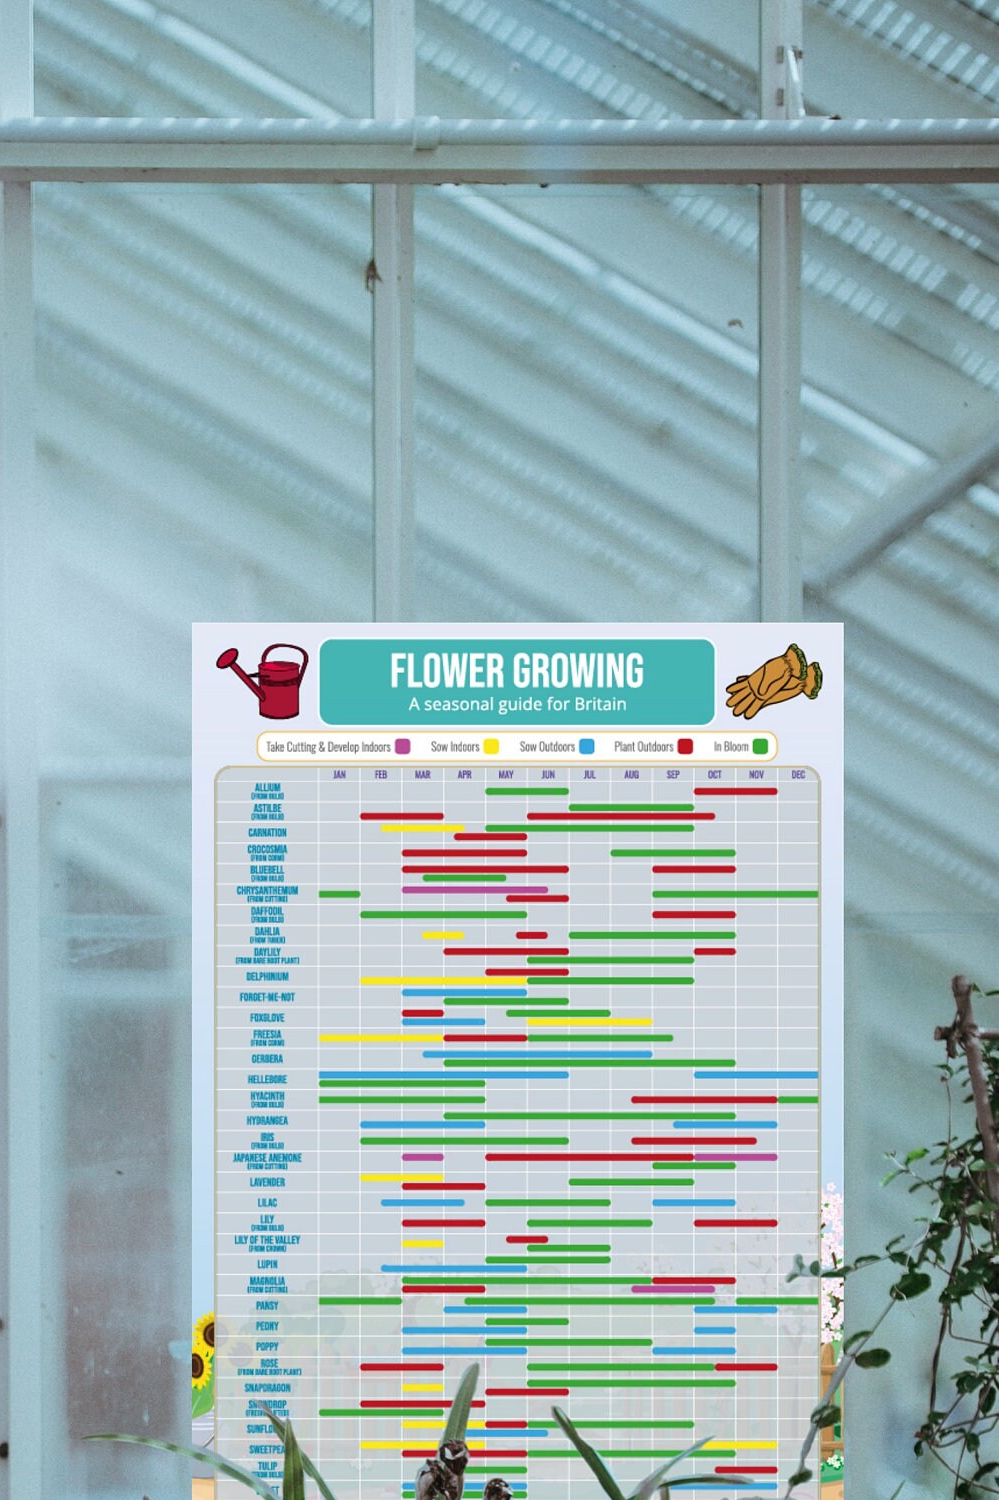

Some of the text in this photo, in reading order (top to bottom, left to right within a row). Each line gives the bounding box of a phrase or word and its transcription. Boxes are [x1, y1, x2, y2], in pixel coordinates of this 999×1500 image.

[391, 652, 644, 688] FLOWER GROWING
[409, 697, 626, 714] A seasonal guide for Britain
[266, 742, 391, 754] Take Cutting & Develop Indoors
[431, 742, 480, 752] Sow Indoors
[520, 741, 576, 752] Sow Outdoors
[615, 741, 674, 752] Plant Outdoors
[714, 741, 749, 752] In Bloom
[333, 770, 346, 779] JAN
[375, 770, 387, 779] FEB
[415, 770, 431, 779] MAR
[458, 770, 472, 779] APR
[499, 770, 513, 779] MAY
[541, 770, 555, 779] JUN
[584, 770, 596, 779] JUL
[624, 770, 639, 779] AUG
[667, 770, 680, 779] SEP
[708, 770, 722, 779] OCT
[749, 770, 764, 779] NOV
[792, 770, 805, 779] DEC
[255, 783, 281, 791] ALLIUM
[254, 804, 282, 812] ASTILBE
[248, 828, 287, 837] CARNATION
[247, 845, 287, 854] CROCOSMIA
[250, 865, 284, 874] BLUEBELL
[237, 886, 298, 895] CHRYSANTHEMUM
[251, 907, 284, 915] DAFFODIL
[255, 927, 280, 936] DAHLIA
[254, 947, 281, 956] DAYLILY
[246, 972, 289, 981] DELPHINIUM
[240, 993, 295, 1002] FORGET-ME-NOT
[250, 1013, 285, 1022] FOXGLOVE
[253, 1030, 281, 1039] FREESIA
[252, 1054, 283, 1063] GERBERA
[248, 1075, 287, 1084] HELLEBORE
[251, 1092, 284, 1100] HYACINTH
[247, 1116, 288, 1125] HYDRANGEA
[261, 1133, 274, 1141] IRIS
[233, 1153, 302, 1162] JAPANESE ANEMONE
[250, 1177, 285, 1187] LAVENDER
[258, 1198, 277, 1207] LILAC
[260, 1215, 274, 1224] LILY
[235, 1235, 300, 1244] LILY OF THE VALLEY
[258, 1260, 277, 1268] LUPIN
[250, 1276, 285, 1285] MAGNOLIA
[256, 1301, 278, 1310] PANSY
[256, 1321, 278, 1331] PEONY
[256, 1342, 278, 1351] POPPY
[261, 1359, 278, 1368] ROSE
[245, 1384, 291, 1392] SNAPDRAGON
[248, 1400, 287, 1408] SNWDROP
[247, 1424, 276, 1434] SUNFLO
[250, 1445, 285, 1454] SWEETPEA
[258, 1461, 277, 1470] TULIP
